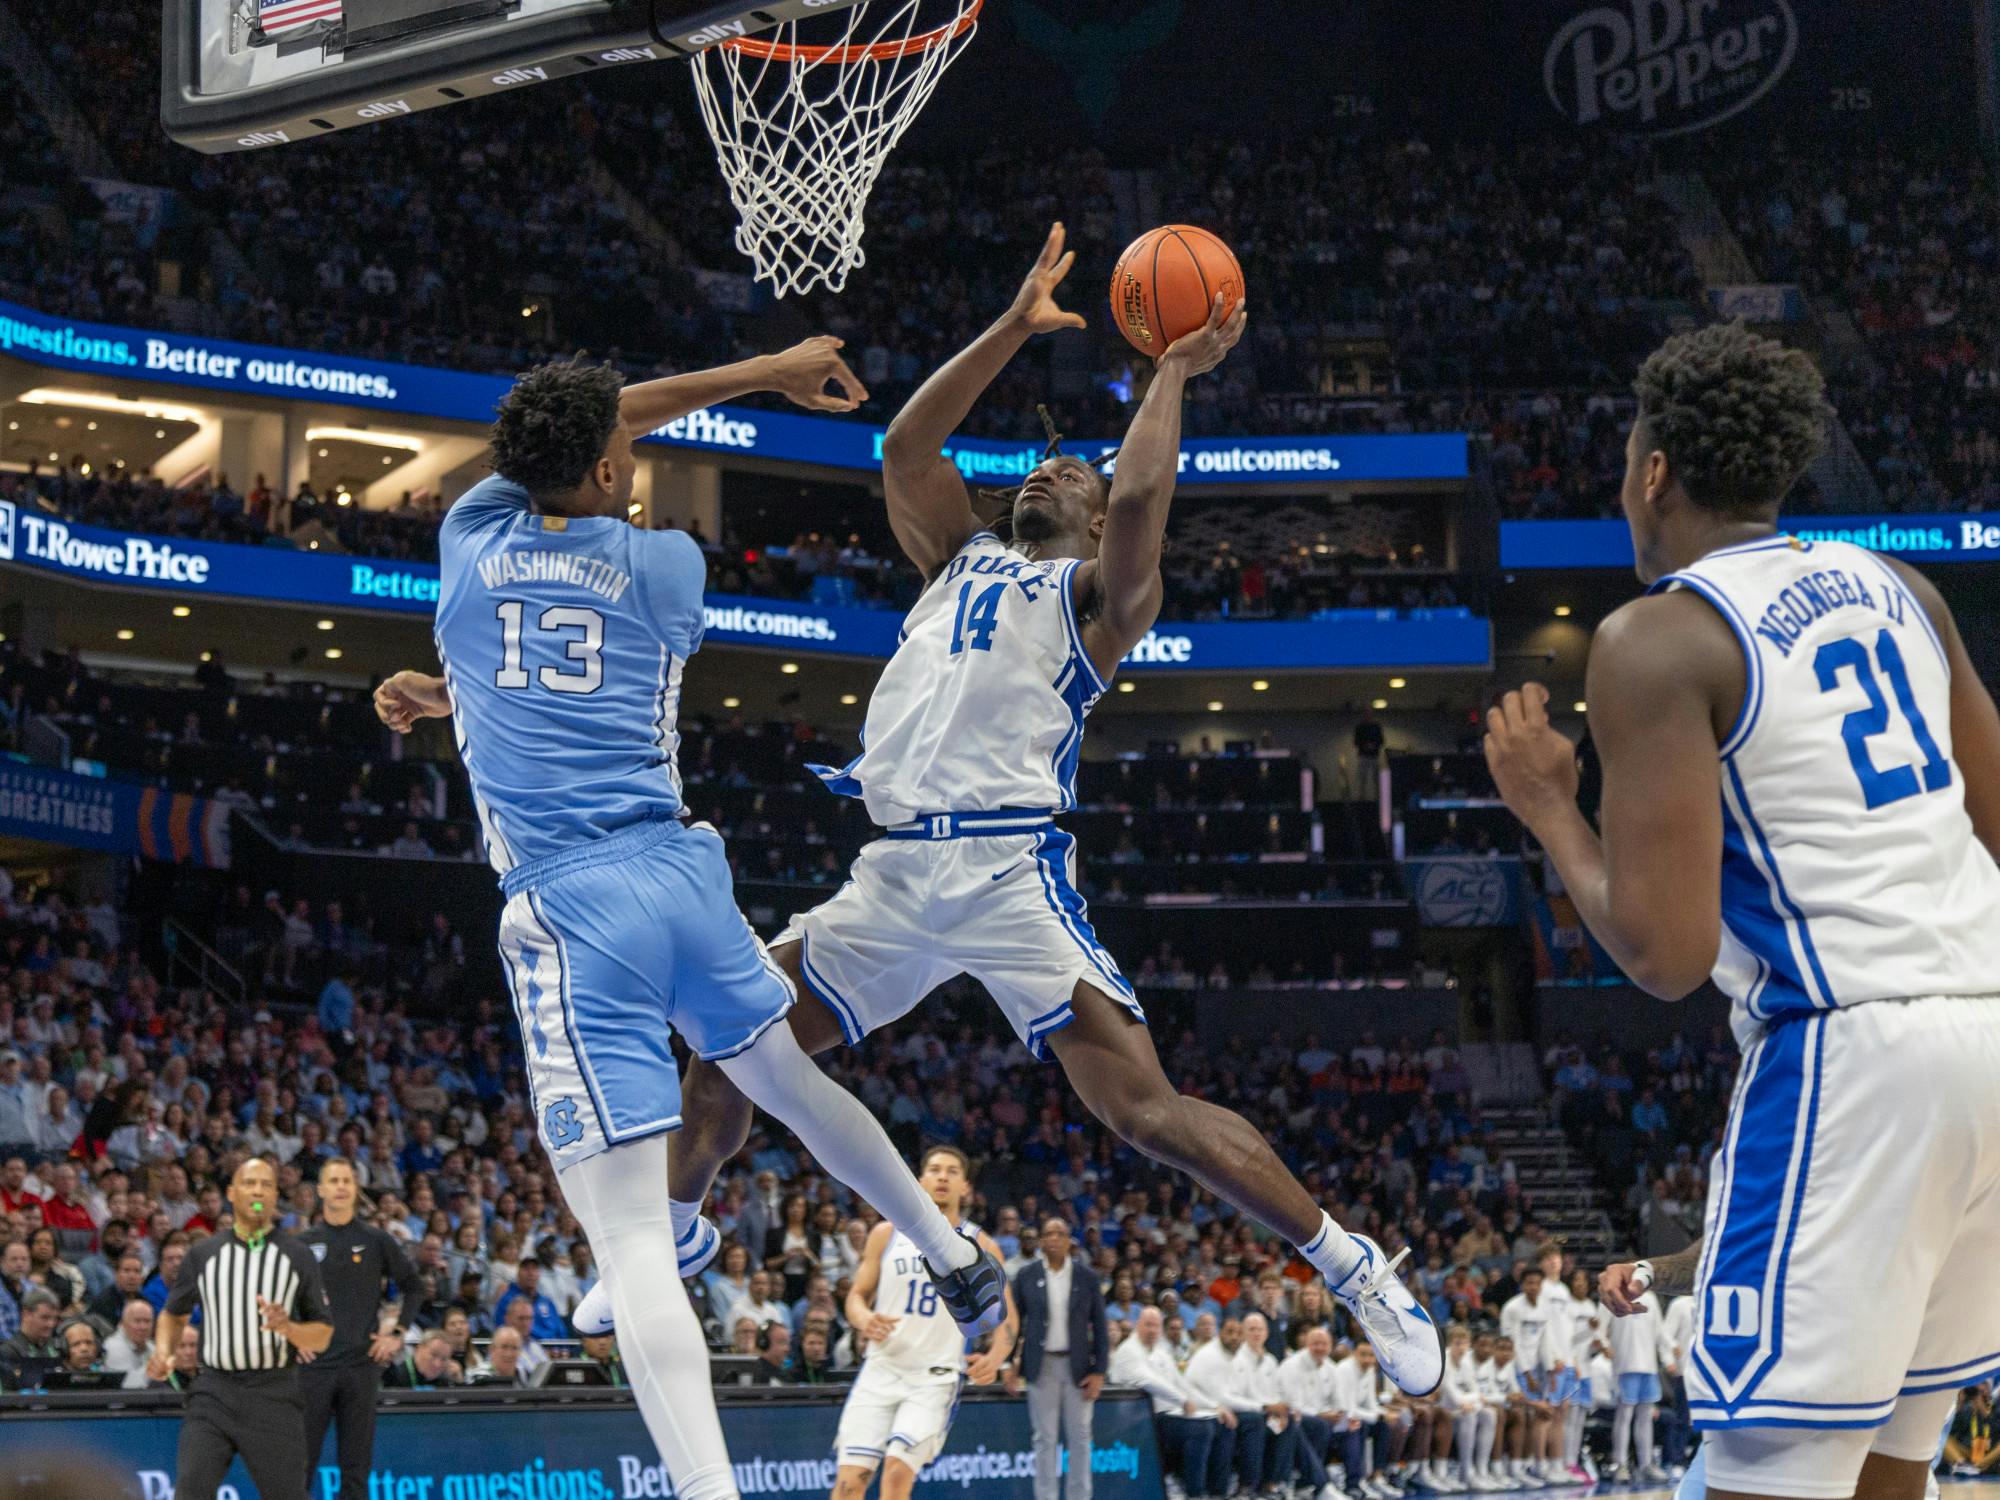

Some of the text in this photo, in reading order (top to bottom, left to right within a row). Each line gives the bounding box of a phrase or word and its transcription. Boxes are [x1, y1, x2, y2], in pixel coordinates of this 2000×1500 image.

[687, 18, 746, 46] ally
[601, 45, 657, 63] ally
[1560, 8, 1779, 125] Pepper
[491, 65, 548, 86] ally
[357, 99, 413, 119] ally
[237, 129, 290, 148] ally
[0, 316, 397, 399] questions. Better outcomes.
[1195, 447, 1341, 472] outcomes.
[351, 564, 440, 602] Better
[477, 551, 631, 603] WASHINGTON
[945, 553, 1058, 603] DUKE
[703, 605, 837, 641] outcomes.
[950, 580, 1009, 656] 14
[1756, 569, 1877, 659] NGONGBA
[495, 600, 606, 694] 13
[1813, 628, 1952, 811] 21
[1429, 879, 1500, 900] ACC
[894, 1257, 924, 1277] DU
[905, 1279, 938, 1318] 18
[1707, 1284, 1760, 1338] D
